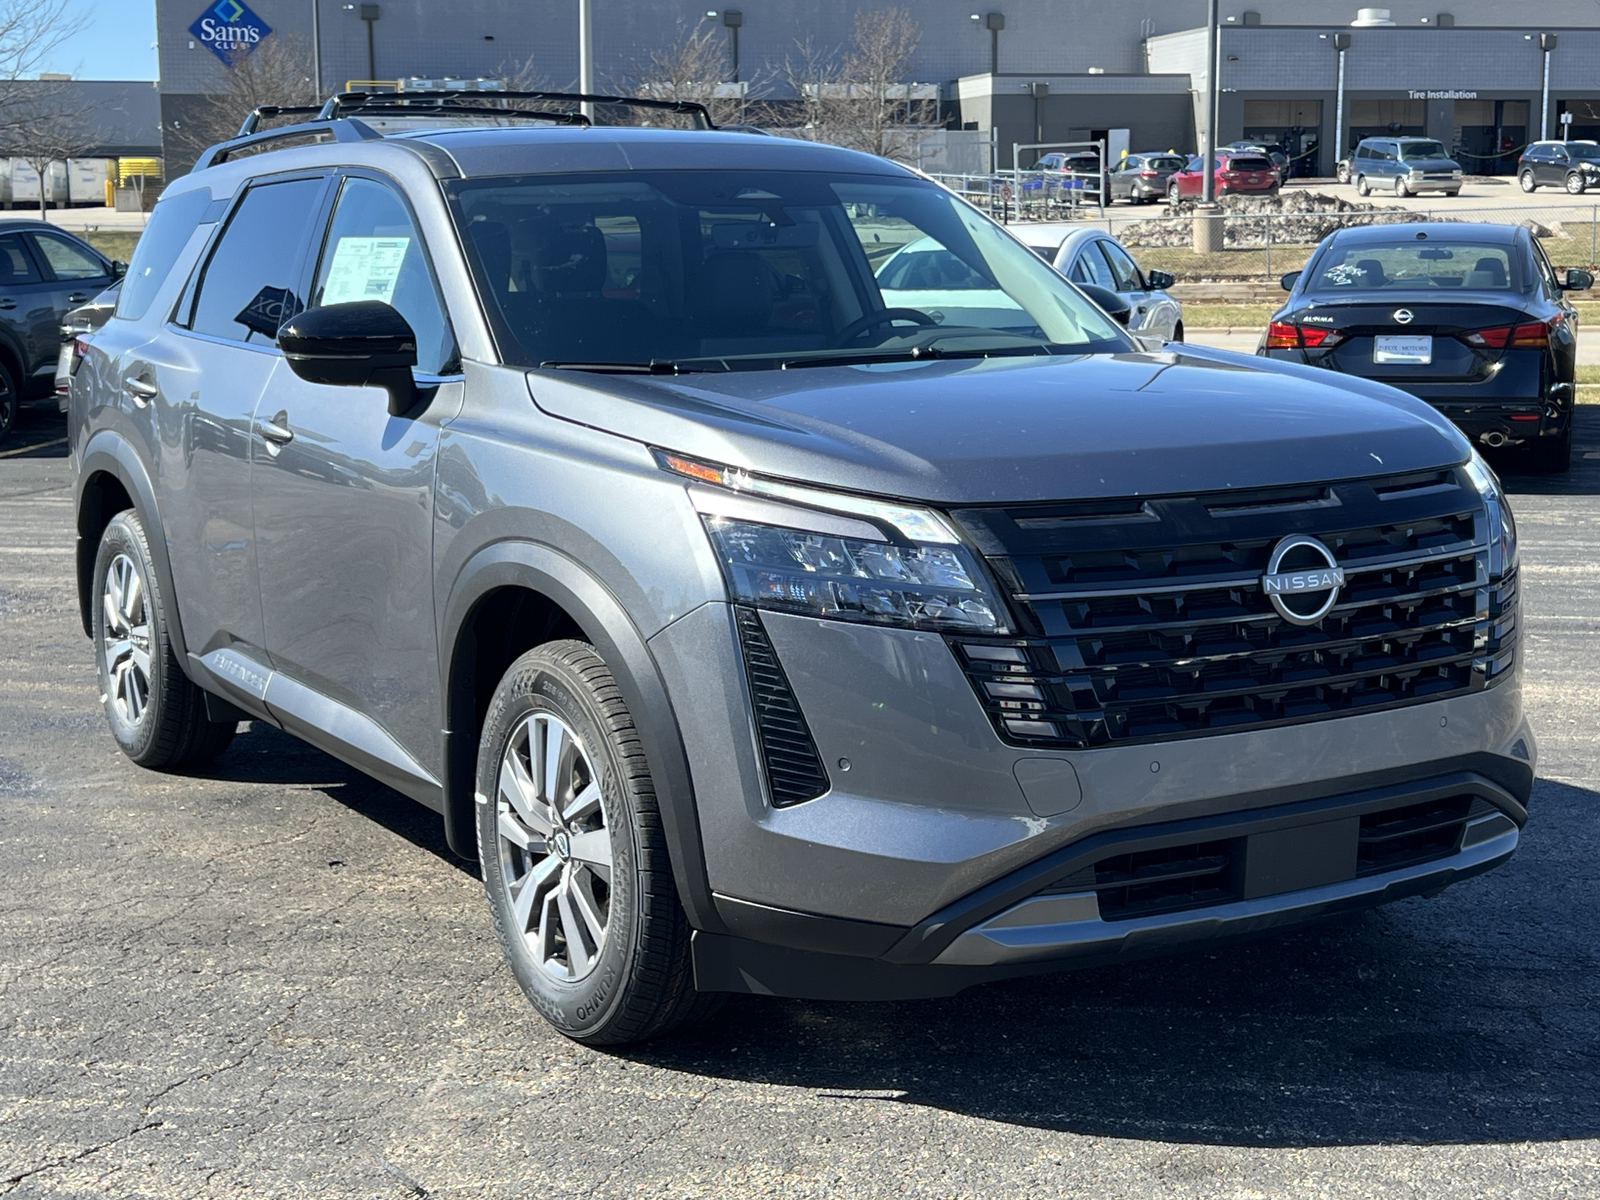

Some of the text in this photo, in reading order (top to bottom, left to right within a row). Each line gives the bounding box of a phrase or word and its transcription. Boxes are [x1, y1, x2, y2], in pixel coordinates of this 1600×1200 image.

[201, 18, 260, 43] Sam's
[1408, 90, 1477, 99] Tire Installation
[1266, 572, 1343, 591] NISSAN
[576, 966, 616, 1021] KUMHO
